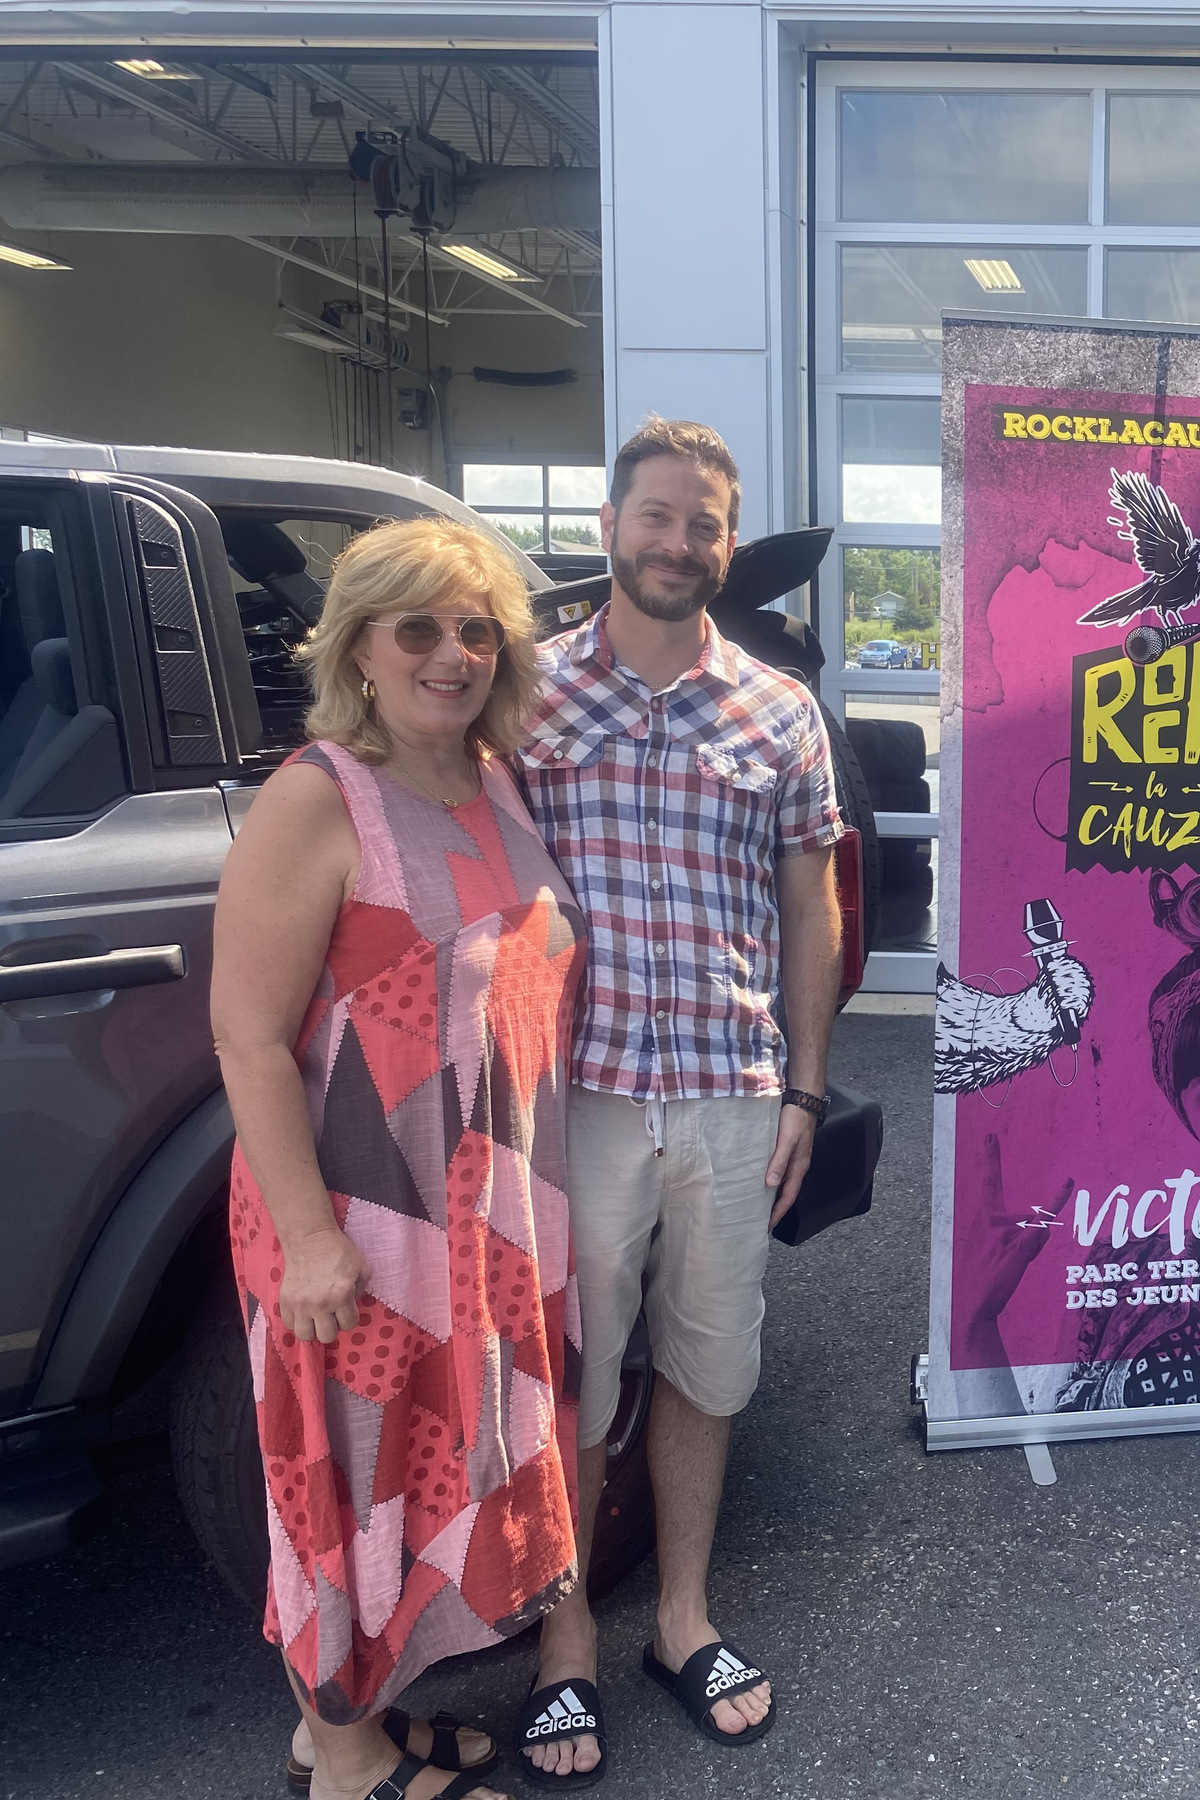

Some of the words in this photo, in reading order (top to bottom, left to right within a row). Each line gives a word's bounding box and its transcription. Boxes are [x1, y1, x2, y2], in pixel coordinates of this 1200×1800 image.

[1145, 770, 1169, 799] la
[1066, 1261, 1139, 1285] PARC
[1066, 1287, 1118, 1310] DES
[704, 1665, 762, 1698] adidas
[525, 1713, 597, 1739] adidas
